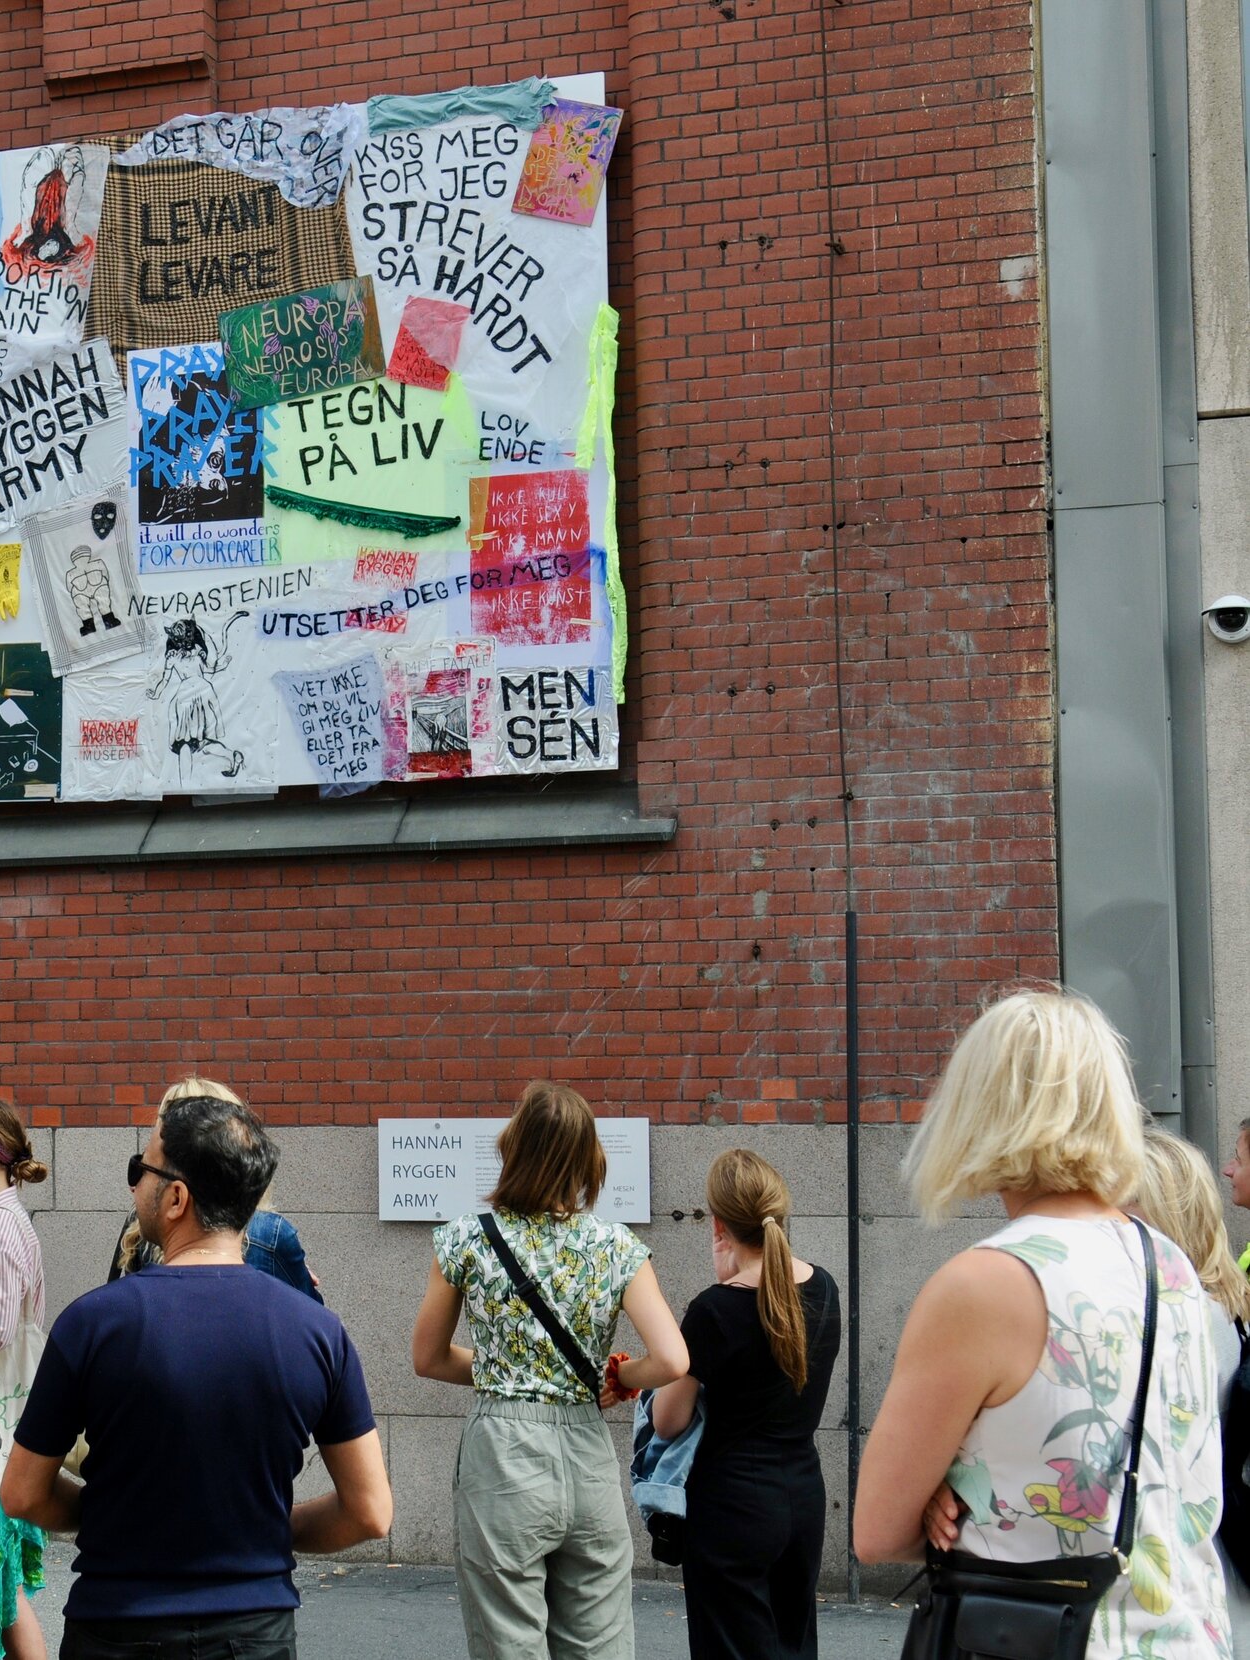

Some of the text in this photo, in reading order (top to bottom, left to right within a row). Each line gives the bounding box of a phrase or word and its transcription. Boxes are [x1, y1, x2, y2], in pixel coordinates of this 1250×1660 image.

[152, 116, 284, 161] DET GÅR
[355, 123, 519, 173] KYSS MEG
[358, 159, 507, 201] FOR JEG
[140, 187, 277, 247] LEVANT
[362, 200, 545, 302] STREVER
[138, 247, 280, 305] LEVARE
[4, 288, 50, 315] THE
[377, 243, 422, 287] SÅ
[433, 255, 552, 374] HARDT
[242, 289, 367, 357] NEUROPA
[244, 326, 350, 375] NEUROSIS
[130, 346, 226, 411] PRAY
[280, 356, 370, 396] EUROPA
[288, 382, 406, 433] TEGN
[481, 411, 530, 438] LOV
[299, 418, 445, 486] PÅ LIV
[478, 437, 547, 465] ENDE
[492, 490, 525, 507] IKKE
[492, 502, 577, 527] IKKE SEXY
[139, 519, 281, 545] it will do wonders
[536, 527, 583, 546] MANN
[139, 537, 281, 569] FOR YOUR CAREER
[360, 546, 417, 565] HANNAH
[357, 559, 414, 579] RYGGEN
[127, 567, 312, 616] NEVRASTENIEN
[261, 554, 572, 638] UTSETTER DEG FOR MEG
[492, 591, 537, 613] IKKE
[293, 666, 368, 698] VET IKKE
[500, 669, 595, 711] MEN
[298, 690, 369, 717] OM VIL
[319, 708, 353, 729] MEG
[307, 723, 371, 751] ELLER TA
[83, 749, 134, 761] MUSEET
[317, 738, 381, 766] DET FRA
[333, 759, 369, 781] MEG
[392, 1135, 462, 1150] HANNAH
[393, 1164, 457, 1179] RYGGEN
[393, 1193, 439, 1208] ARMY
